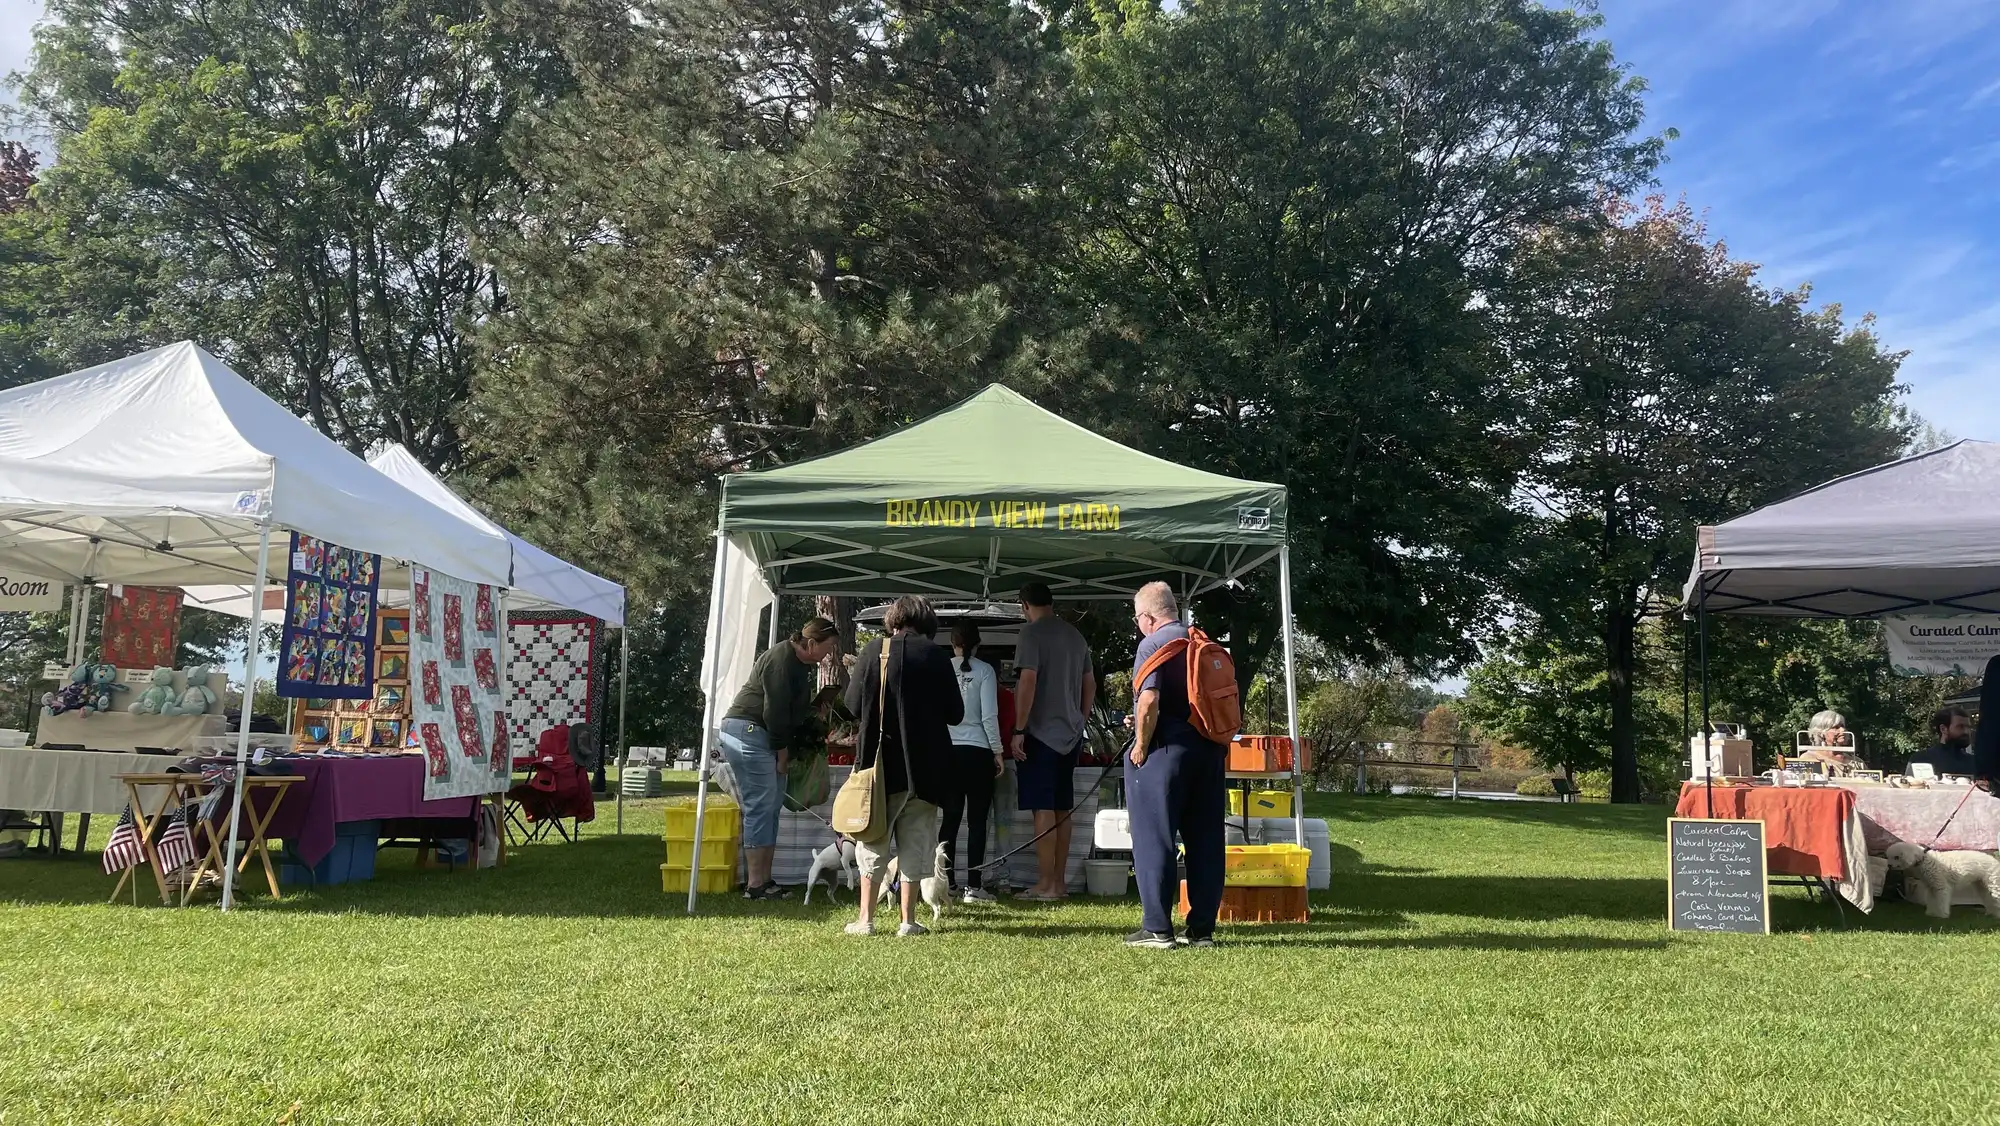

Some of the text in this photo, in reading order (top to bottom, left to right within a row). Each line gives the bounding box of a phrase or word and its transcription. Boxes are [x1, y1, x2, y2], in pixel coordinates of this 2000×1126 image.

[886, 499, 1120, 531] BRANDY VIEW FARM
[0, 576, 49, 597] Room
[1909, 625, 1965, 636] Curated
[1683, 824, 1758, 840] Curated Calm
[1676, 837, 1704, 847] Natural
[1676, 852, 1706, 861] Candles
[1720, 853, 1751, 863] Balms
[1725, 864, 1751, 877] Soaps
[1717, 902, 1750, 912] Venmo
[1738, 914, 1760, 922] Check
